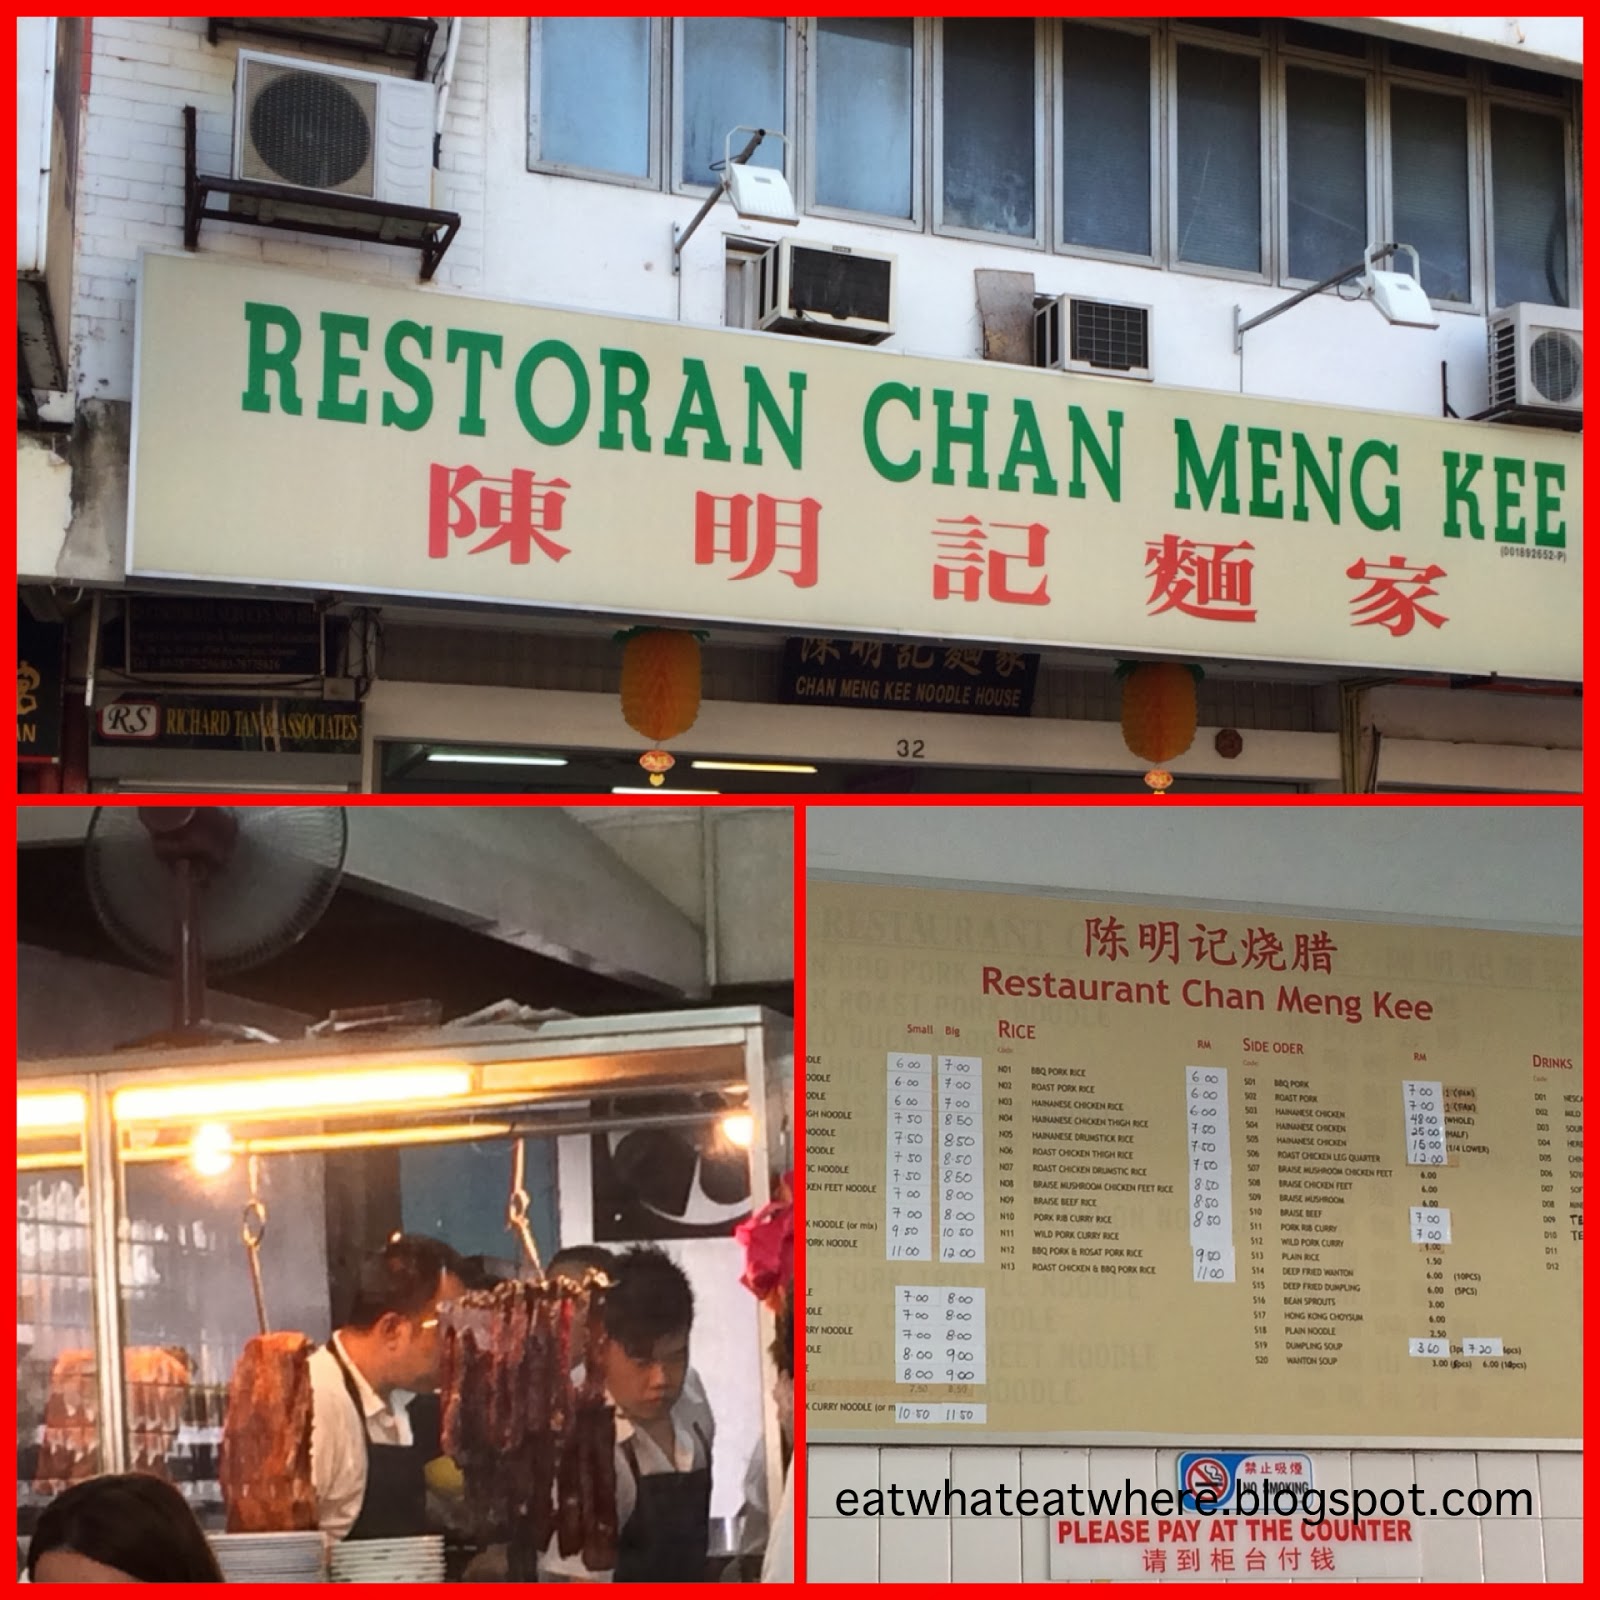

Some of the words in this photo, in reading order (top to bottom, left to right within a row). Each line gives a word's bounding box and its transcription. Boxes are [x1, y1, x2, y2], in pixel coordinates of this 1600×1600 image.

[242, 302, 807, 469] RESTORAN
[863, 381, 1124, 502] CHAN
[1174, 418, 1401, 531] MENG
[1443, 450, 1567, 548] KEE
[428, 463, 1448, 637] 陳明記麵家
[796, 676, 836, 697] CHAN
[840, 679, 880, 699] MENG
[884, 681, 911, 701] KEE
[915, 683, 971, 705] NOODLE
[975, 687, 1021, 708] HOUSE
[166, 708, 230, 736] RICHARD
[234, 710, 262, 737] TAN
[279, 712, 358, 740] ASSOCIATES
[896, 739, 926, 759] 32
[1084, 915, 1338, 975] 陈明记烧腊
[982, 966, 1171, 1005] Restaurant
[1182, 979, 1265, 1011] Chan
[1276, 985, 1363, 1024] Meng
[1373, 991, 1433, 1021] Kee
[907, 1024, 933, 1035] Small
[945, 1026, 960, 1037] Big
[1197, 1040, 1212, 1049] RM
[1413, 1052, 1427, 1061] RM
[1031, 1066, 1047, 1076] BBQ
[1047, 1067, 1068, 1076] PORK
[1069, 1068, 1086, 1077] RICE
[1031, 1082, 1055, 1091] ROAST
[1057, 1084, 1077, 1092] PORK
[1078, 1085, 1095, 1094] RICE
[1274, 1079, 1289, 1089] BBQ
[1290, 1080, 1309, 1088] PORK
[1274, 1093, 1298, 1102] ROAST
[1299, 1094, 1318, 1103] PORK
[1031, 1100, 1072, 1109] HAINANESE
[1073, 1101, 1106, 1110] CHICKEN
[1107, 1102, 1124, 1111] RICE
[821, 1111, 852, 1120] NOODLE
[1275, 1108, 1314, 1117] HAINANESE
[1314, 1110, 1345, 1119] CHICKEN
[1031, 1115, 1072, 1124] HAINANESE
[1073, 1117, 1106, 1126] CHICKEN
[1107, 1118, 1131, 1127] THIGH
[1132, 1119, 1149, 1128] RICE
[1032, 1147, 1057, 1156] ROAST
[1058, 1149, 1090, 1158] CHICKEN
[1091, 1150, 1116, 1159] THIGH
[1117, 1151, 1134, 1160] RICE
[1277, 1150, 1300, 1159] ROAST
[1301, 1151, 1332, 1160] CHICKEN
[1332, 1153, 1347, 1161] LEG
[1348, 1154, 1381, 1163] QUARTER
[1032, 1164, 1057, 1172] ROAST
[1058, 1164, 1091, 1174] CHICKEN
[1130, 1167, 1147, 1176] RICE
[825, 1184, 843, 1192] FEET
[846, 1185, 877, 1193] NOODLE
[1033, 1180, 1058, 1189] BRAISE
[1103, 1183, 1136, 1192] CHICKEN
[1137, 1183, 1155, 1193] FEET
[1157, 1184, 1173, 1193] RICE
[1278, 1179, 1302, 1188] BRAISE
[1303, 1180, 1335, 1189] CHICKEN
[1335, 1181, 1353, 1190] FEET
[1033, 1196, 1059, 1206] BRAISE
[1060, 1197, 1079, 1206] BEEF
[1080, 1198, 1097, 1207] RICE
[1279, 1194, 1303, 1203] BRAISE
[1280, 1208, 1304, 1217] BRAISE
[1305, 1209, 1322, 1218] BEEF
[812, 1221, 844, 1230] NOODLE
[1033, 1230, 1053, 1238] WILD
[1054, 1230, 1075, 1239] PORK
[1076, 1231, 1101, 1240] CURRY
[1102, 1231, 1119, 1240] RICE
[1280, 1238, 1300, 1246] WILD
[1300, 1238, 1320, 1247] PORK
[1321, 1239, 1344, 1247] CURRY
[1032, 1246, 1048, 1256] BBQ
[1049, 1246, 1069, 1255] PORK
[1104, 1248, 1125, 1257] PORK
[1126, 1249, 1143, 1258] RICE
[1281, 1252, 1302, 1261] PLAIN
[1303, 1253, 1320, 1262] RICE
[1032, 1263, 1057, 1271] ROAST
[1058, 1264, 1091, 1272] CHICKEN
[1100, 1265, 1117, 1275] BBQ
[1117, 1265, 1138, 1274] PORK
[1139, 1265, 1156, 1275] RICE
[1282, 1267, 1300, 1276] DEEP
[1301, 1267, 1322, 1276] FRIED
[1323, 1268, 1354, 1277] WANTON
[1283, 1282, 1301, 1290] DEEP
[1302, 1282, 1323, 1291] FRIED
[1324, 1283, 1361, 1292] DUMPLING
[1283, 1296, 1303, 1305] BEAN
[1303, 1297, 1336, 1306] SPROUTS
[1284, 1311, 1306, 1320] HONG
[1307, 1312, 1328, 1320] KONG
[1284, 1326, 1306, 1335] PLAIN
[1307, 1327, 1336, 1336] NOODLE
[1285, 1341, 1322, 1350] DUMPLING
[1323, 1342, 1343, 1351] SOUP
[1286, 1356, 1317, 1365] WANTON
[1318, 1356, 1338, 1365] SOUP
[812, 1402, 838, 1411] CURRY
[840, 1403, 872, 1412] NOODLE
[1244, 1462, 1303, 1475] 禁止吸煙
[1058, 1519, 1150, 1544] PLEASE
[1158, 1519, 1201, 1543] PAY
[1209, 1519, 1238, 1542] AT
[1246, 1519, 1292, 1541] THE
[1301, 1519, 1412, 1542] COUNTER
[1142, 1546, 1335, 1574] 请到柜台付钱
